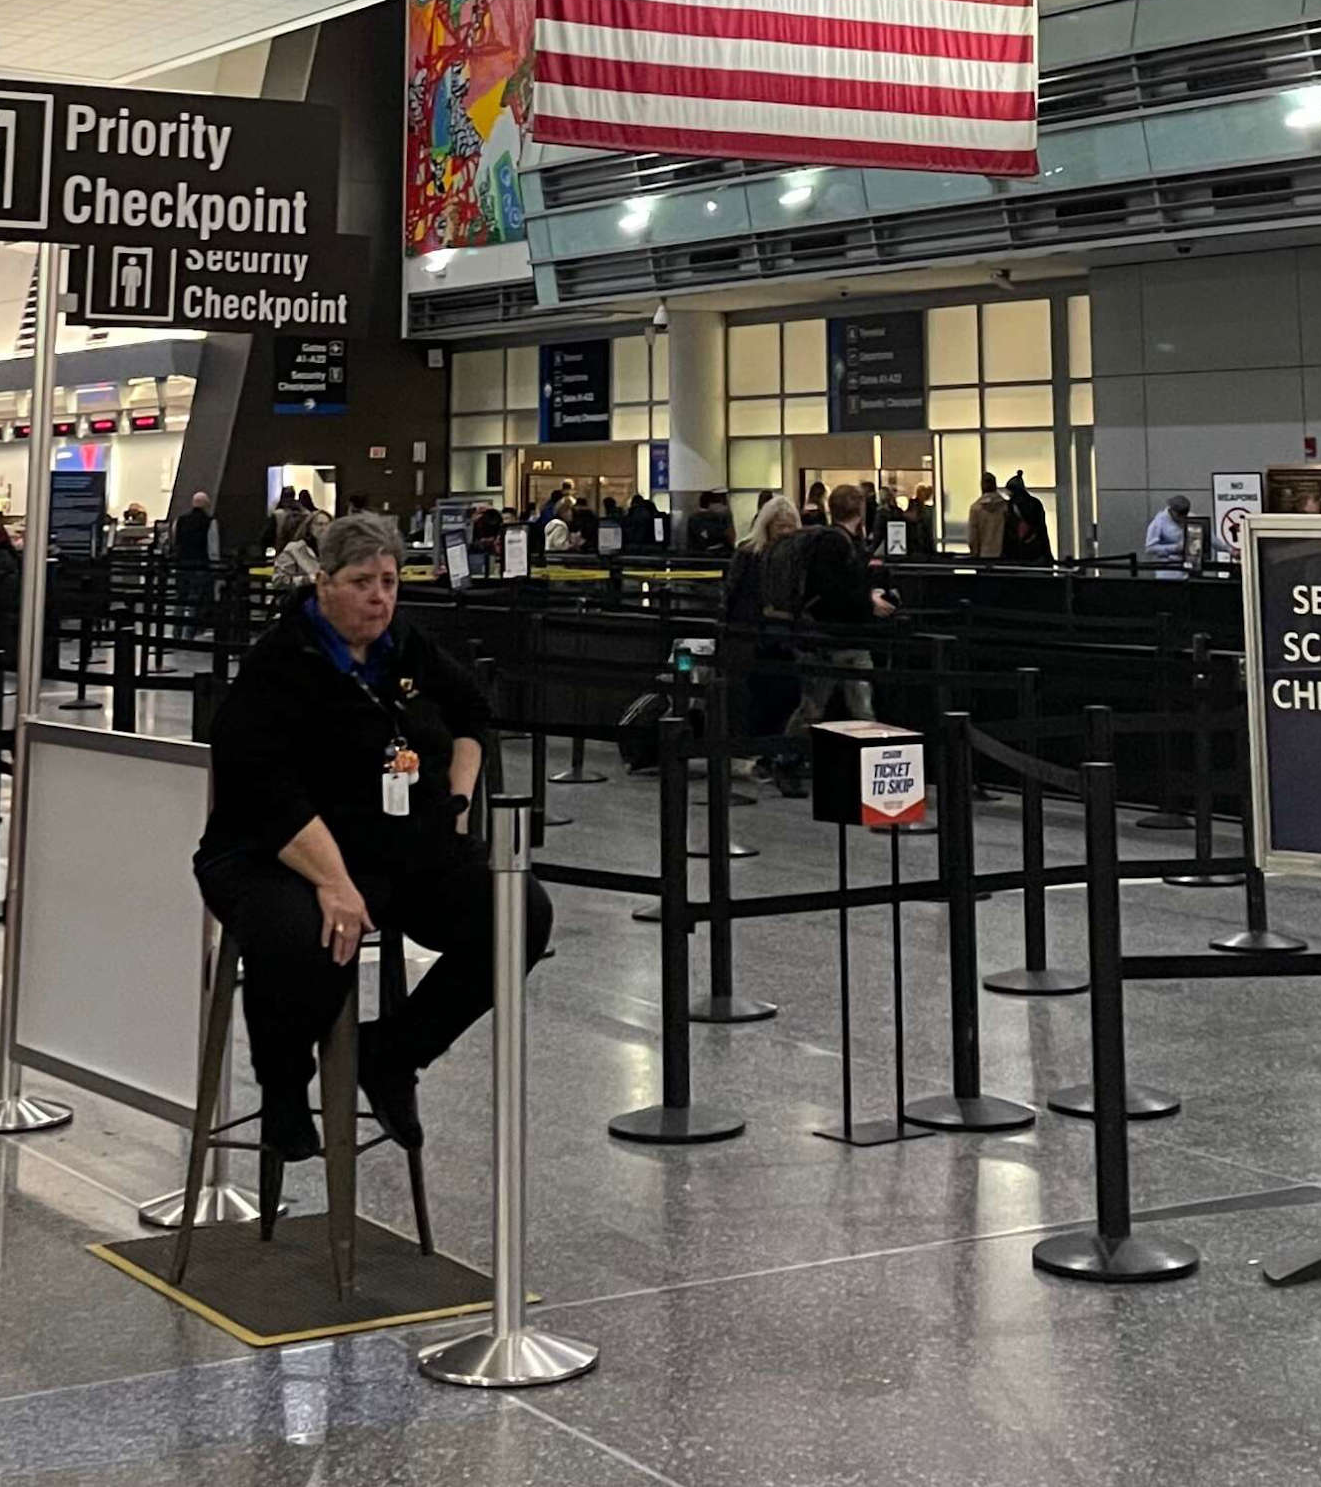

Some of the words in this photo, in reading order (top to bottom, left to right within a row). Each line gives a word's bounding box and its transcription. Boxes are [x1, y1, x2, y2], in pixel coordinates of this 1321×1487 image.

[66, 104, 232, 171] Priority
[62, 175, 307, 240] Checkpoint
[185, 248, 309, 282] Security
[182, 285, 347, 328] Checkpoint
[1230, 481, 1244, 490] NO
[872, 779, 886, 796] TO
[887, 778, 915, 794] SKIP
[874, 761, 912, 779] TICKET
